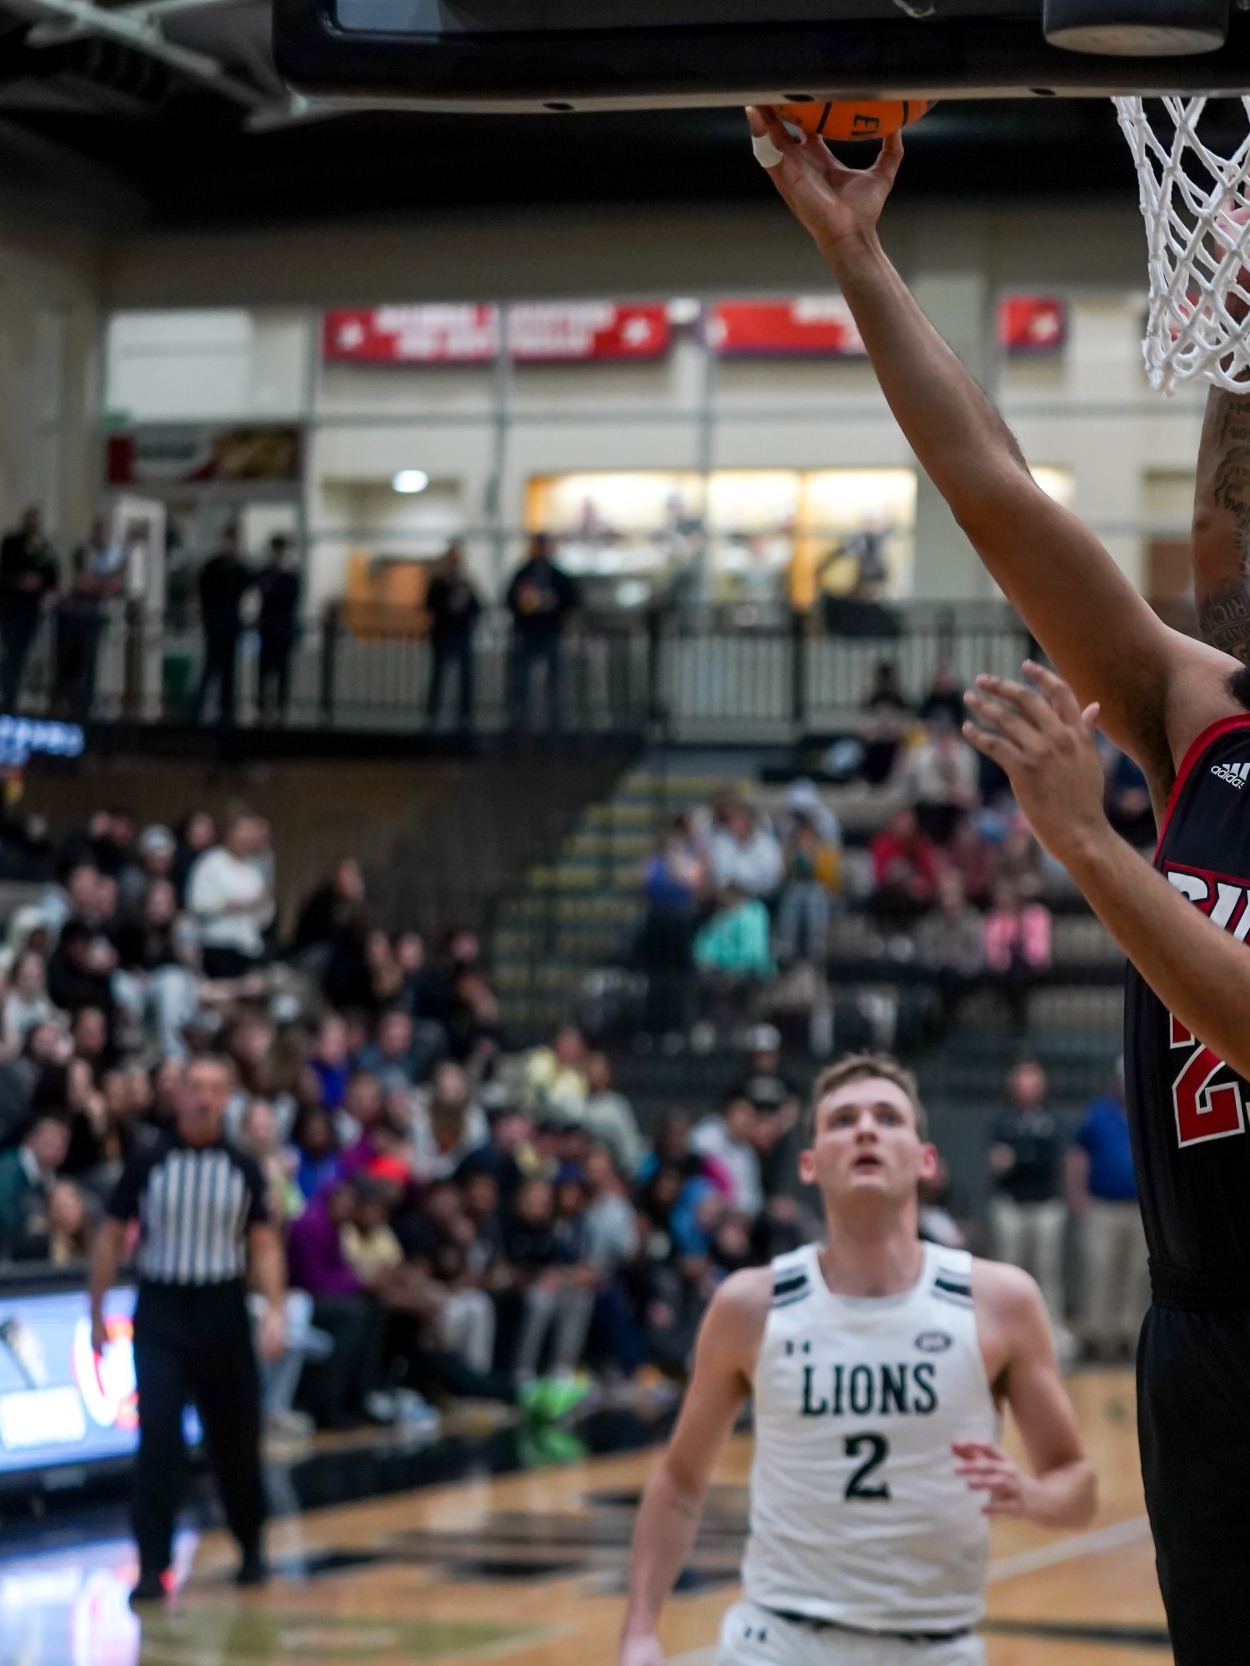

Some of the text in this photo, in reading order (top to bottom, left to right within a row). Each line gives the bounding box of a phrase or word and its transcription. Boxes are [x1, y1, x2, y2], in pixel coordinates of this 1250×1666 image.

[1210, 765, 1246, 790] adidas
[801, 1361, 939, 1417] LIONS
[842, 1432, 892, 1501] 2
